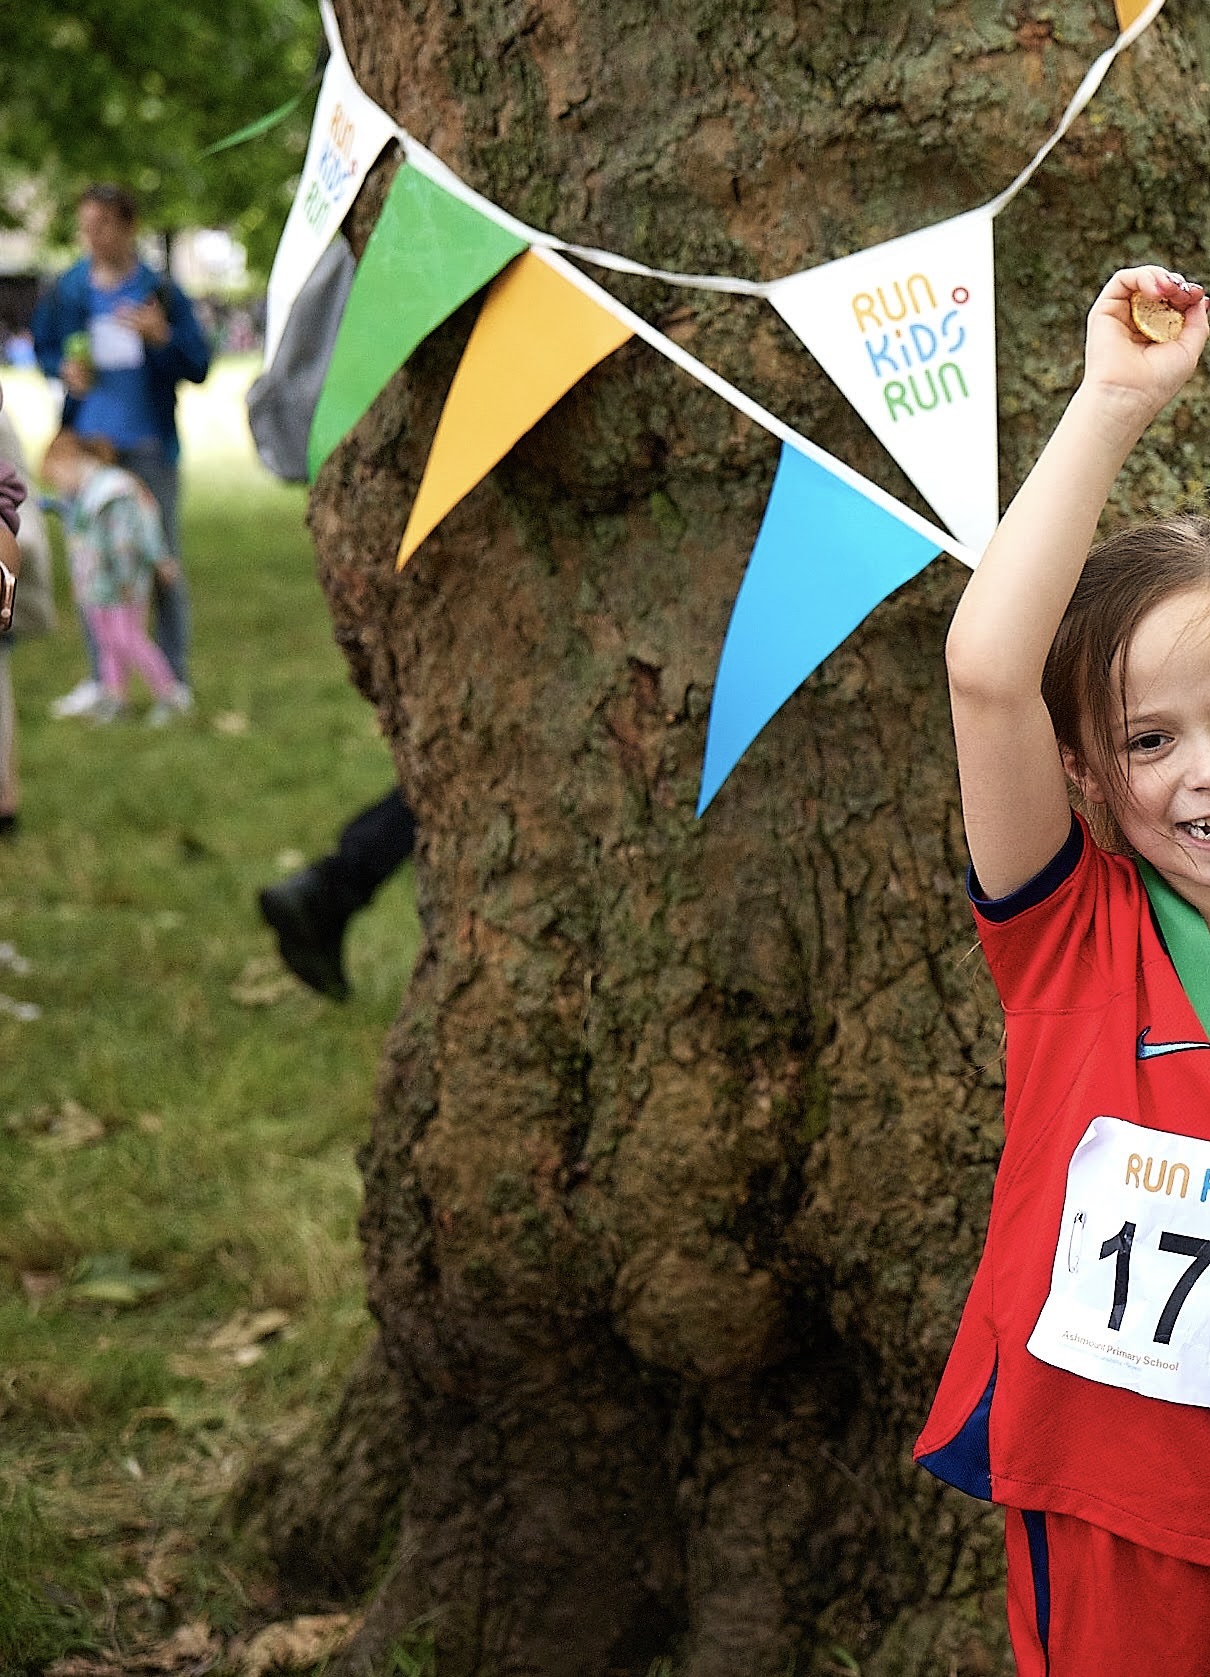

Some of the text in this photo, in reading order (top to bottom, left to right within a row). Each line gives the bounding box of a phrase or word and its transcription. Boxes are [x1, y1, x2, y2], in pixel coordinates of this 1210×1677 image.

[851, 273, 938, 333] RUN
[883, 362, 969, 432] RUN
[1125, 1153, 1190, 1198] RUN
[1106, 1344, 1142, 1365] Primary
[1142, 1354, 1180, 1372] School
